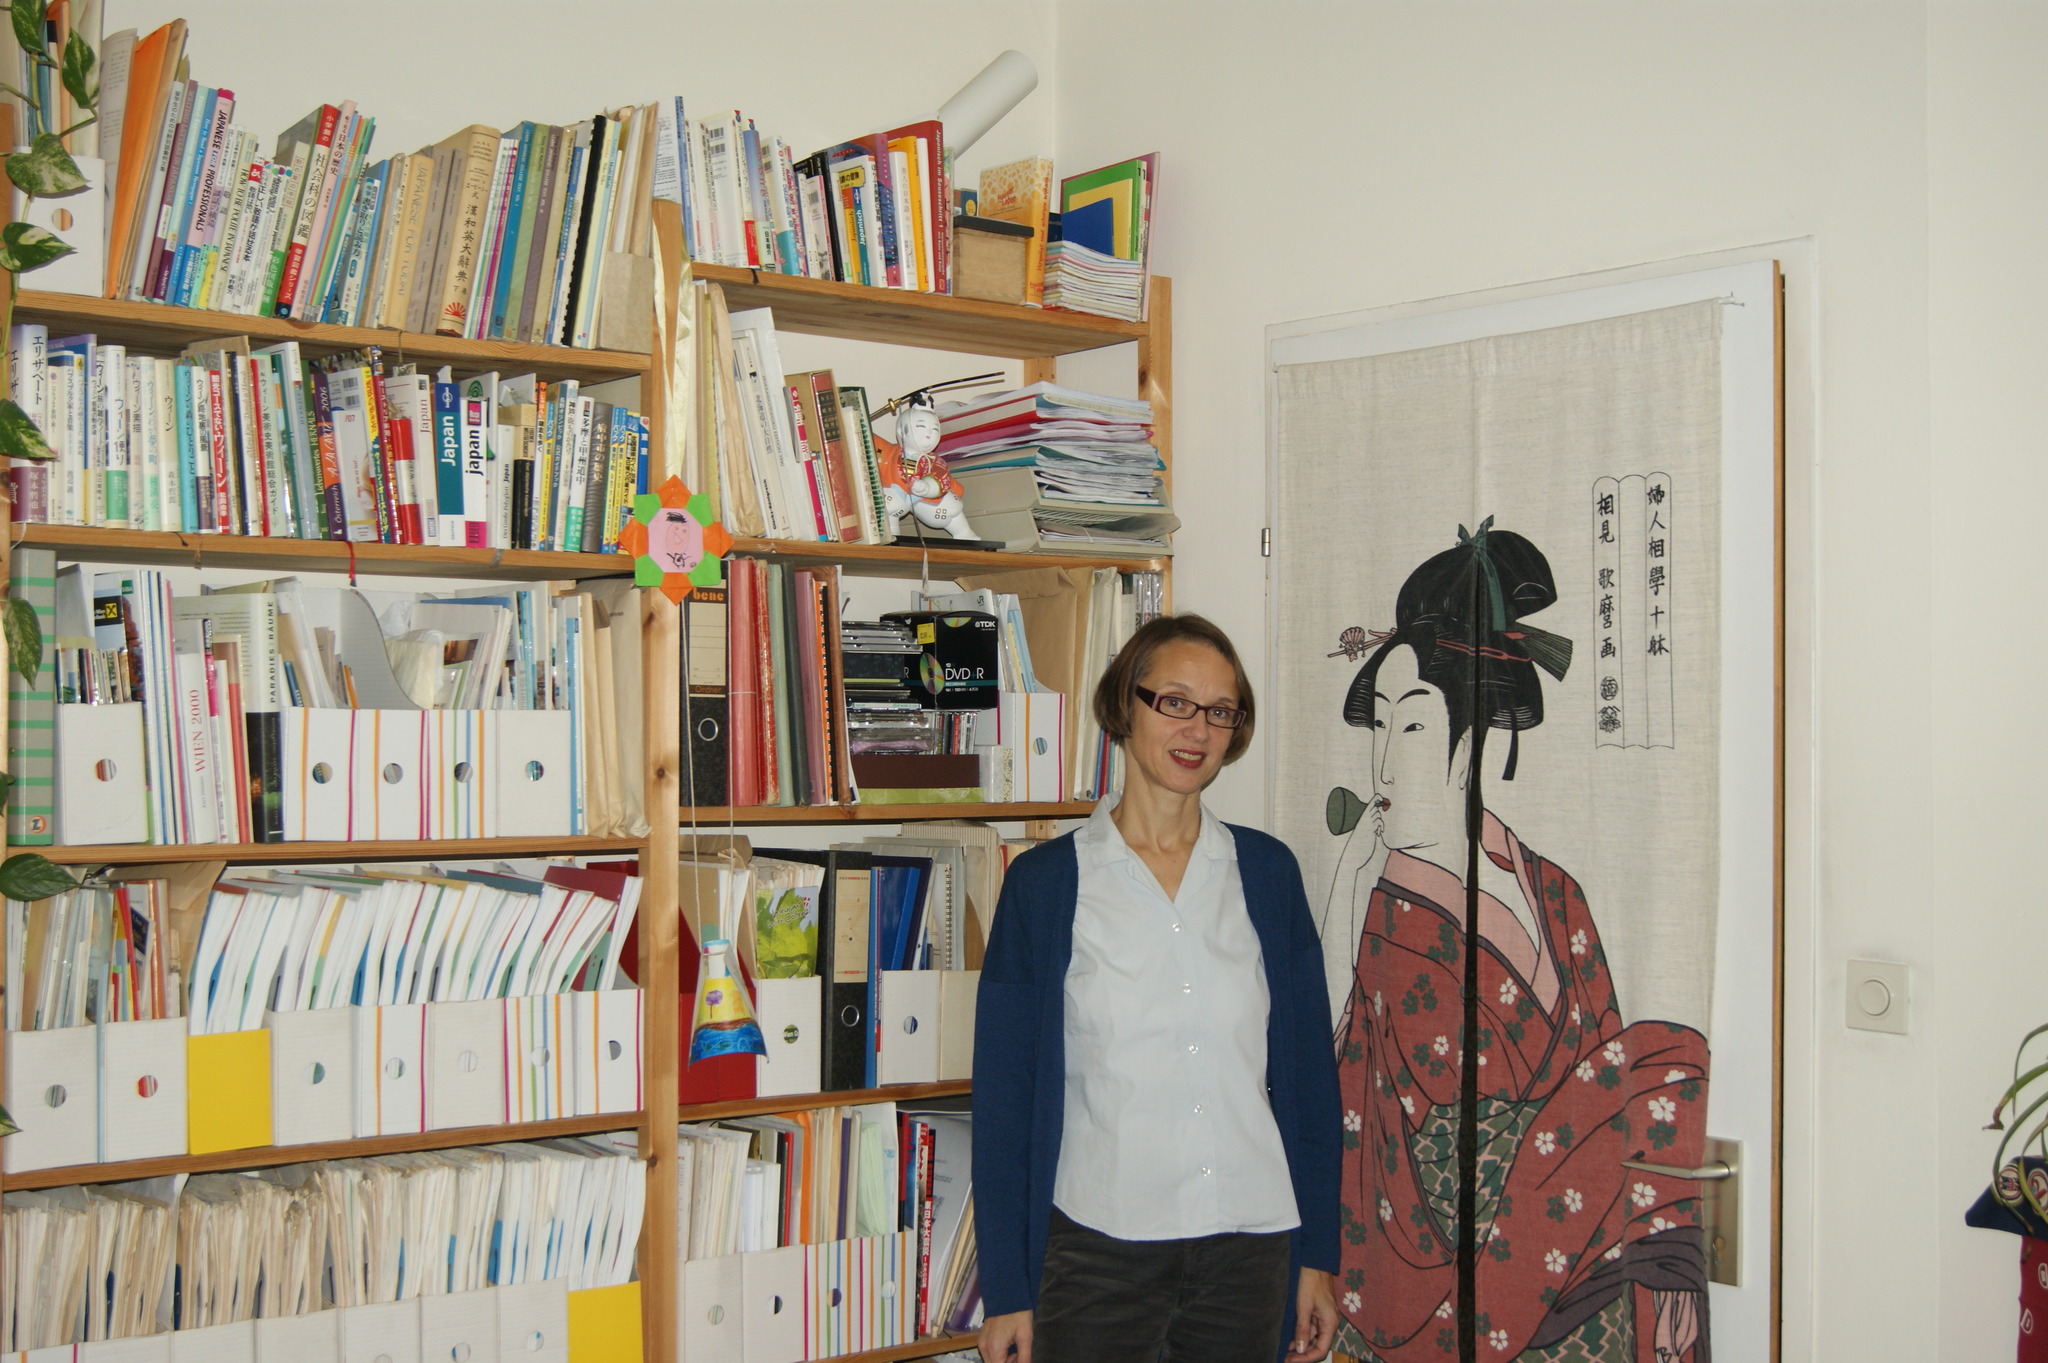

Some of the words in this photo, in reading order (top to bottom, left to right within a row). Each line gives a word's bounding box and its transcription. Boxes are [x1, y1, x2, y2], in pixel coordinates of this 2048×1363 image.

[211, 109, 226, 149] JAPANESE
[321, 114, 334, 141] 小学館の
[237, 168, 249, 186] HOW
[936, 166, 942, 175] im
[195, 168, 215, 232] PROFESSIONALS
[233, 197, 243, 206] BE
[235, 187, 245, 198] TO
[296, 152, 326, 238] 社会科の図鑑
[407, 163, 428, 226] JAPANESE
[936, 178, 944, 221] Sauseschritt
[225, 232, 235, 241] IN
[228, 208, 240, 231] POLITE
[855, 209, 866, 245] Japanisch
[219, 241, 233, 273] JAPANESE
[402, 229, 418, 254] FOR
[395, 259, 412, 298] TODAY
[32, 335, 43, 404] エリザベート
[164, 395, 173, 431] ウィーン
[320, 386, 329, 411] 2006
[418, 399, 431, 433] Japan
[114, 398, 125, 465] ウィーン便り
[209, 373, 228, 487] 観光コースでないウィーン
[309, 410, 317, 445] HERNALS
[439, 415, 458, 466] Japan
[464, 429, 484, 475] japan
[312, 448, 324, 494] Liebenswertes
[332, 484, 341, 522] Österreich
[1596, 493, 1615, 543] 相見
[693, 587, 725, 601] bene
[695, 685, 722, 693] Ordner
[945, 667, 984, 681] DVD+R
[188, 688, 201, 724] 2000
[192, 730, 206, 771] WIEN
